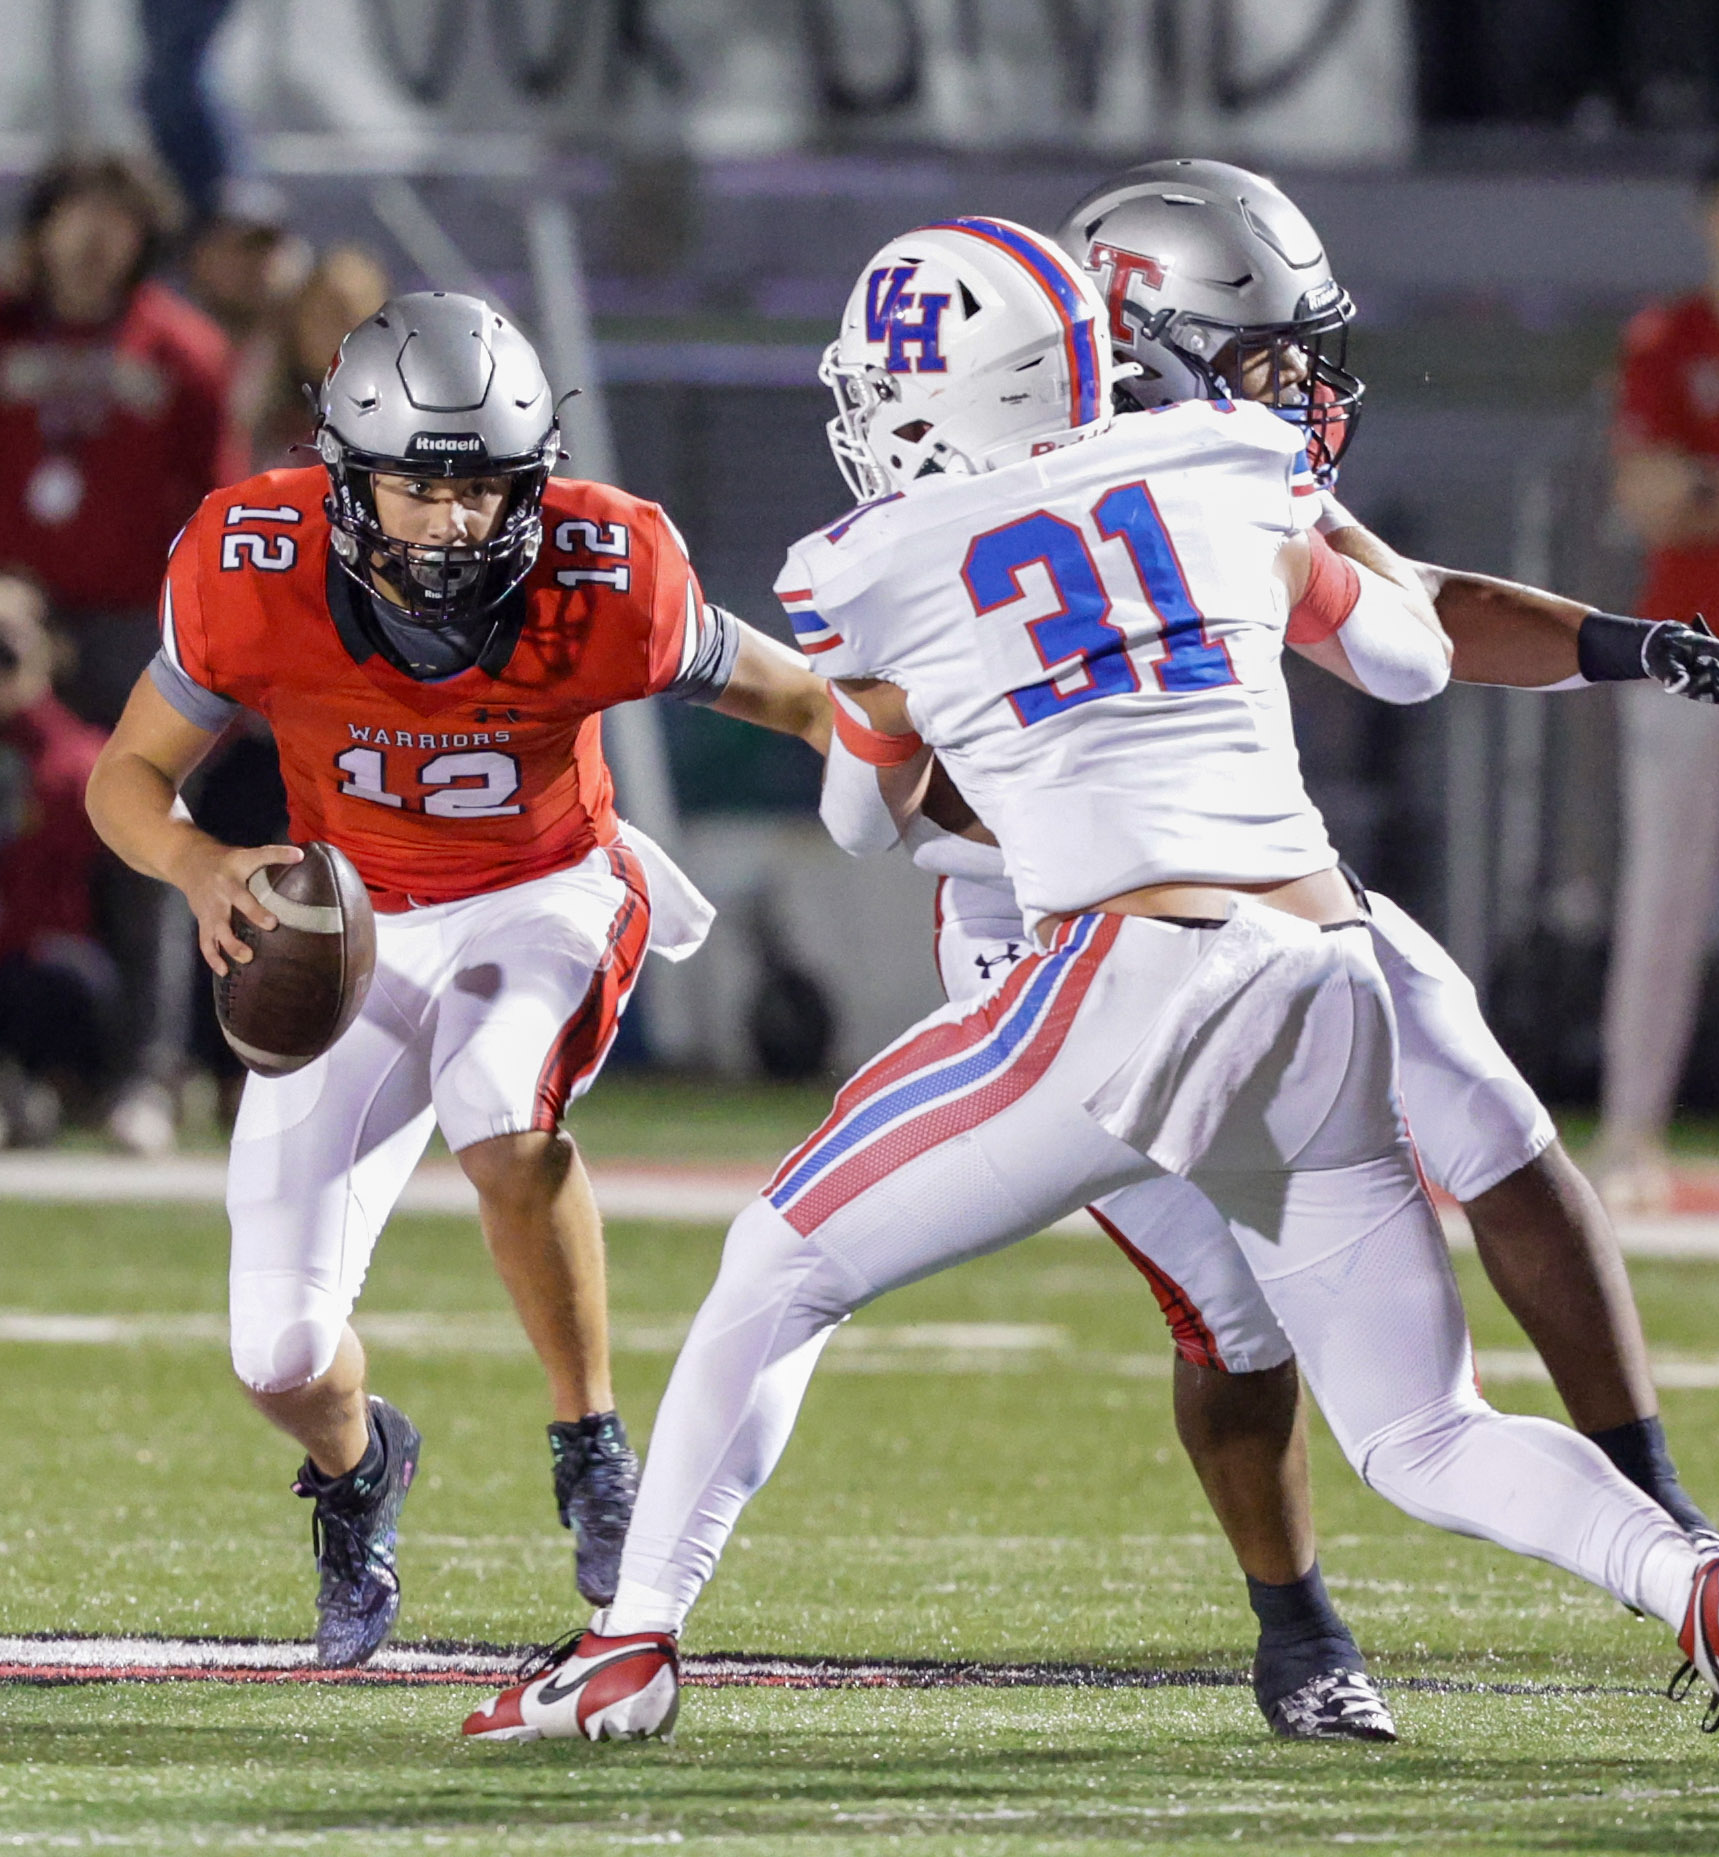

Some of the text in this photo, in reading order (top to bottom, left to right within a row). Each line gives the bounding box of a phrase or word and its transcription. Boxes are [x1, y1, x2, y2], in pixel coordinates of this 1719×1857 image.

[866, 266, 952, 374] VH
[1083, 240, 1167, 347] T
[220, 504, 302, 574] 12
[554, 518, 632, 595] 12
[959, 479, 1244, 729] 31
[347, 722, 512, 749] WARRIORS
[334, 745, 526, 820] 12
